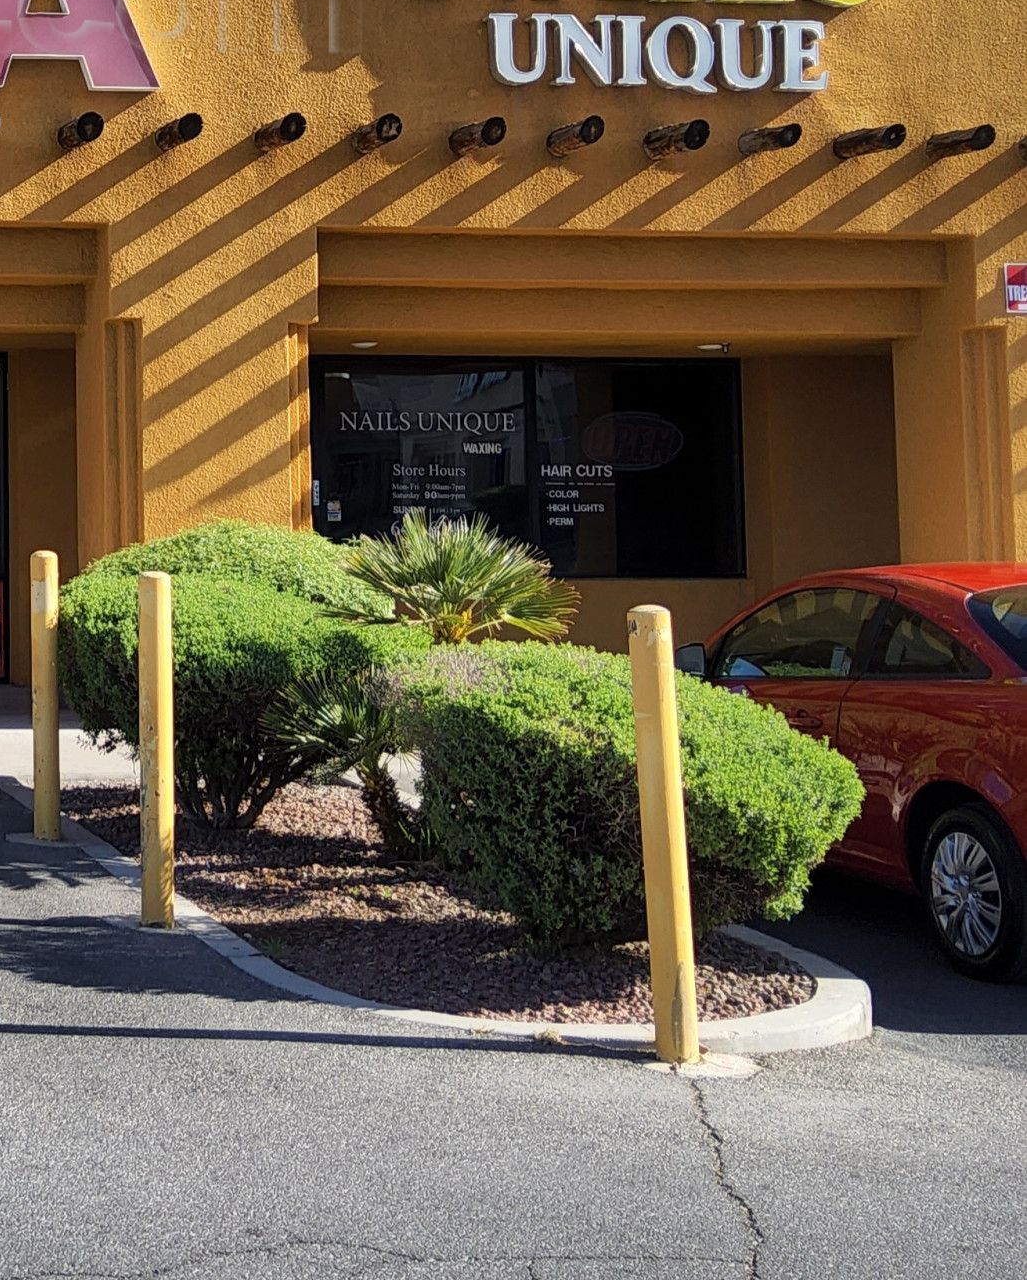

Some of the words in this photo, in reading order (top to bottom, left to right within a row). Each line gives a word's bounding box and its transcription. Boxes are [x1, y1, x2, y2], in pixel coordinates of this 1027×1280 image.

[485, 12, 831, 94] UNIQUE
[340, 411, 411, 432] NAILS
[417, 412, 516, 435] UNIQUE
[462, 441, 503, 455] WAXING
[392, 463, 425, 476] Store
[428, 463, 466, 477] Hours
[540, 464, 572, 477] HAIR
[575, 464, 614, 478] CUTS
[548, 489, 580, 498] COLOR
[548, 503, 570, 512] HIGH
[572, 503, 605, 512] LIGHTS
[549, 517, 574, 526] PERM
